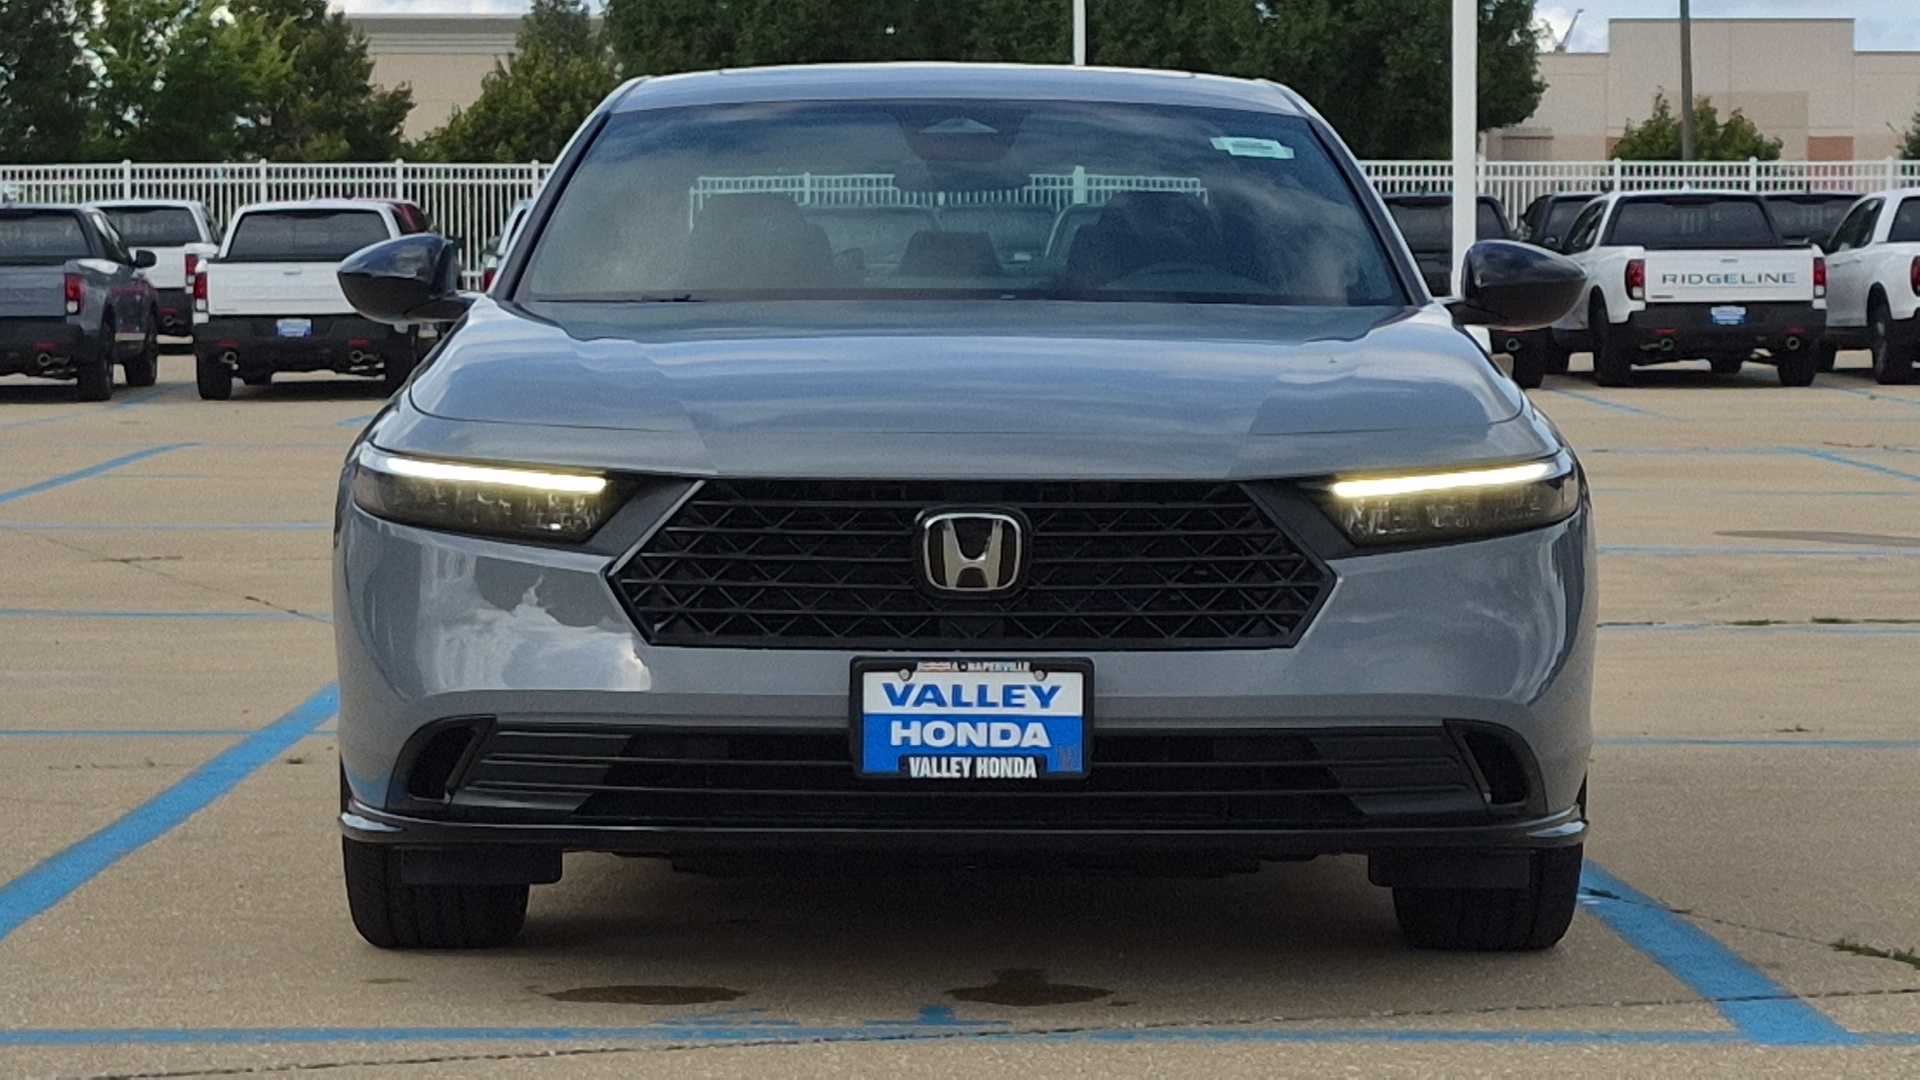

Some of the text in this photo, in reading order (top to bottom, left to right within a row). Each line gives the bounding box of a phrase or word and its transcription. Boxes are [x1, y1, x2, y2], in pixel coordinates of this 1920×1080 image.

[1662, 272, 1797, 285] RIDGELINE
[882, 682, 1062, 709] VALLEY
[890, 720, 1052, 748] HONDA
[909, 756, 972, 778] VALLEY
[976, 756, 1038, 779] HONDA
